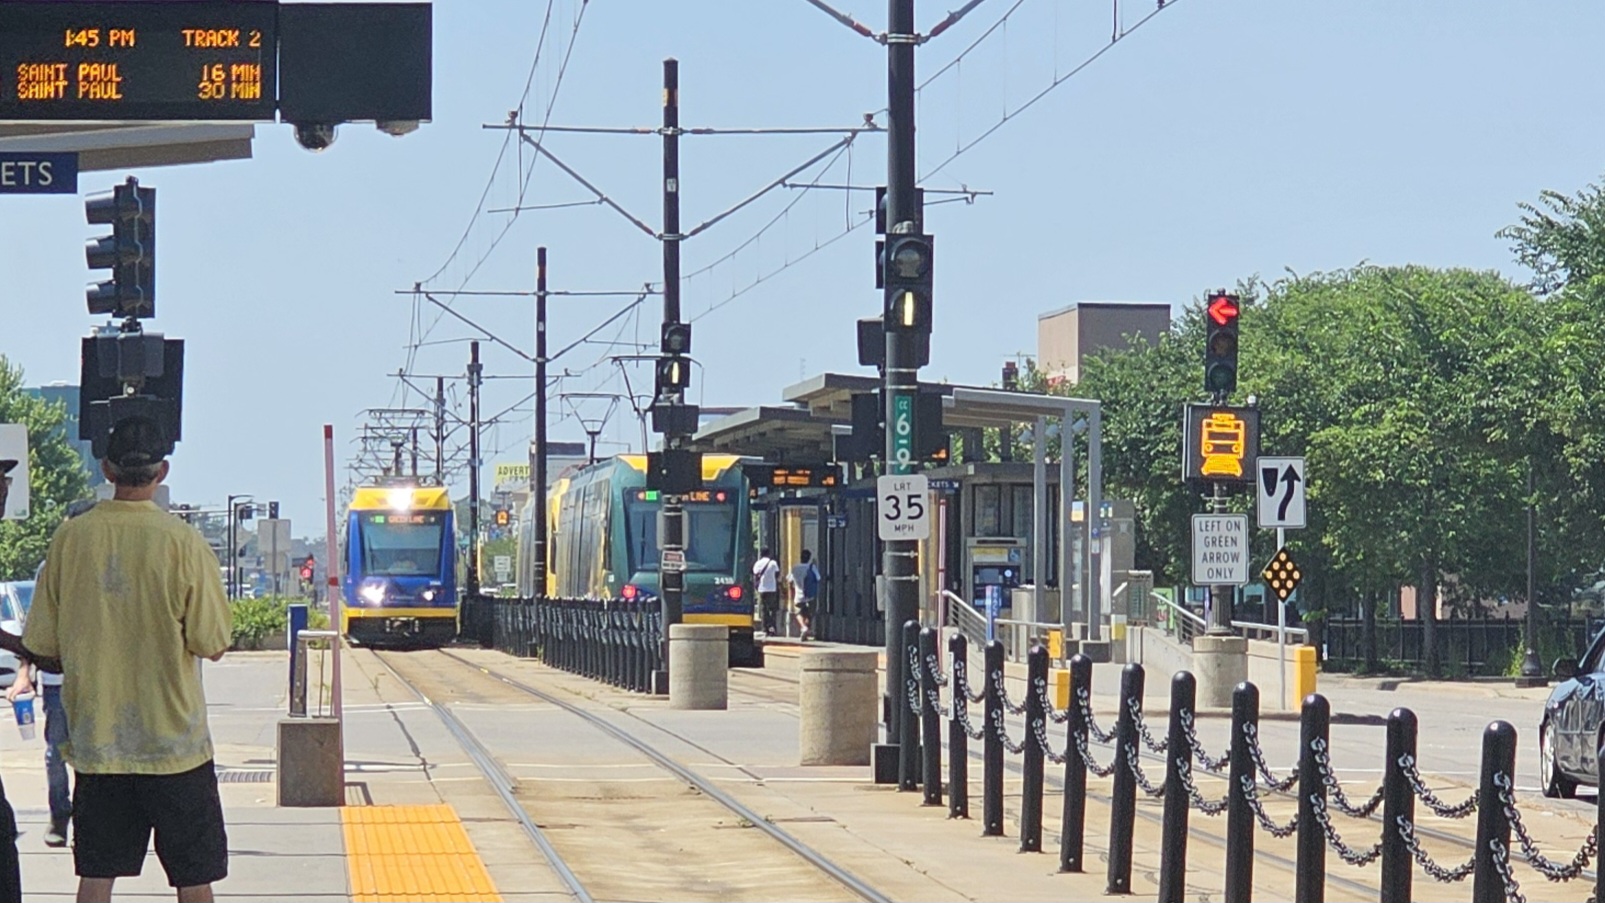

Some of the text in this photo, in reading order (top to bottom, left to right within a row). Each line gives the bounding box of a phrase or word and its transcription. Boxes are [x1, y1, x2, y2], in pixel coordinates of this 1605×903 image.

[109, 29, 135, 47] PM
[182, 29, 261, 47] TRACK 2
[17, 63, 122, 82] SAINT PAUL
[202, 64, 261, 81] 16 MIN
[17, 81, 122, 99] SAINT PAUL
[198, 81, 261, 99] 30 MIN
[1, 161, 53, 186] ETS
[893, 481, 912, 492] LRT
[884, 493, 924, 521] 35
[894, 524, 914, 533] MPH
[1199, 520, 1241, 533] LEFT ON
[1203, 534, 1238, 548] GREEN
[1201, 551, 1240, 564] ARROW
[1206, 567, 1234, 580] ONLY
